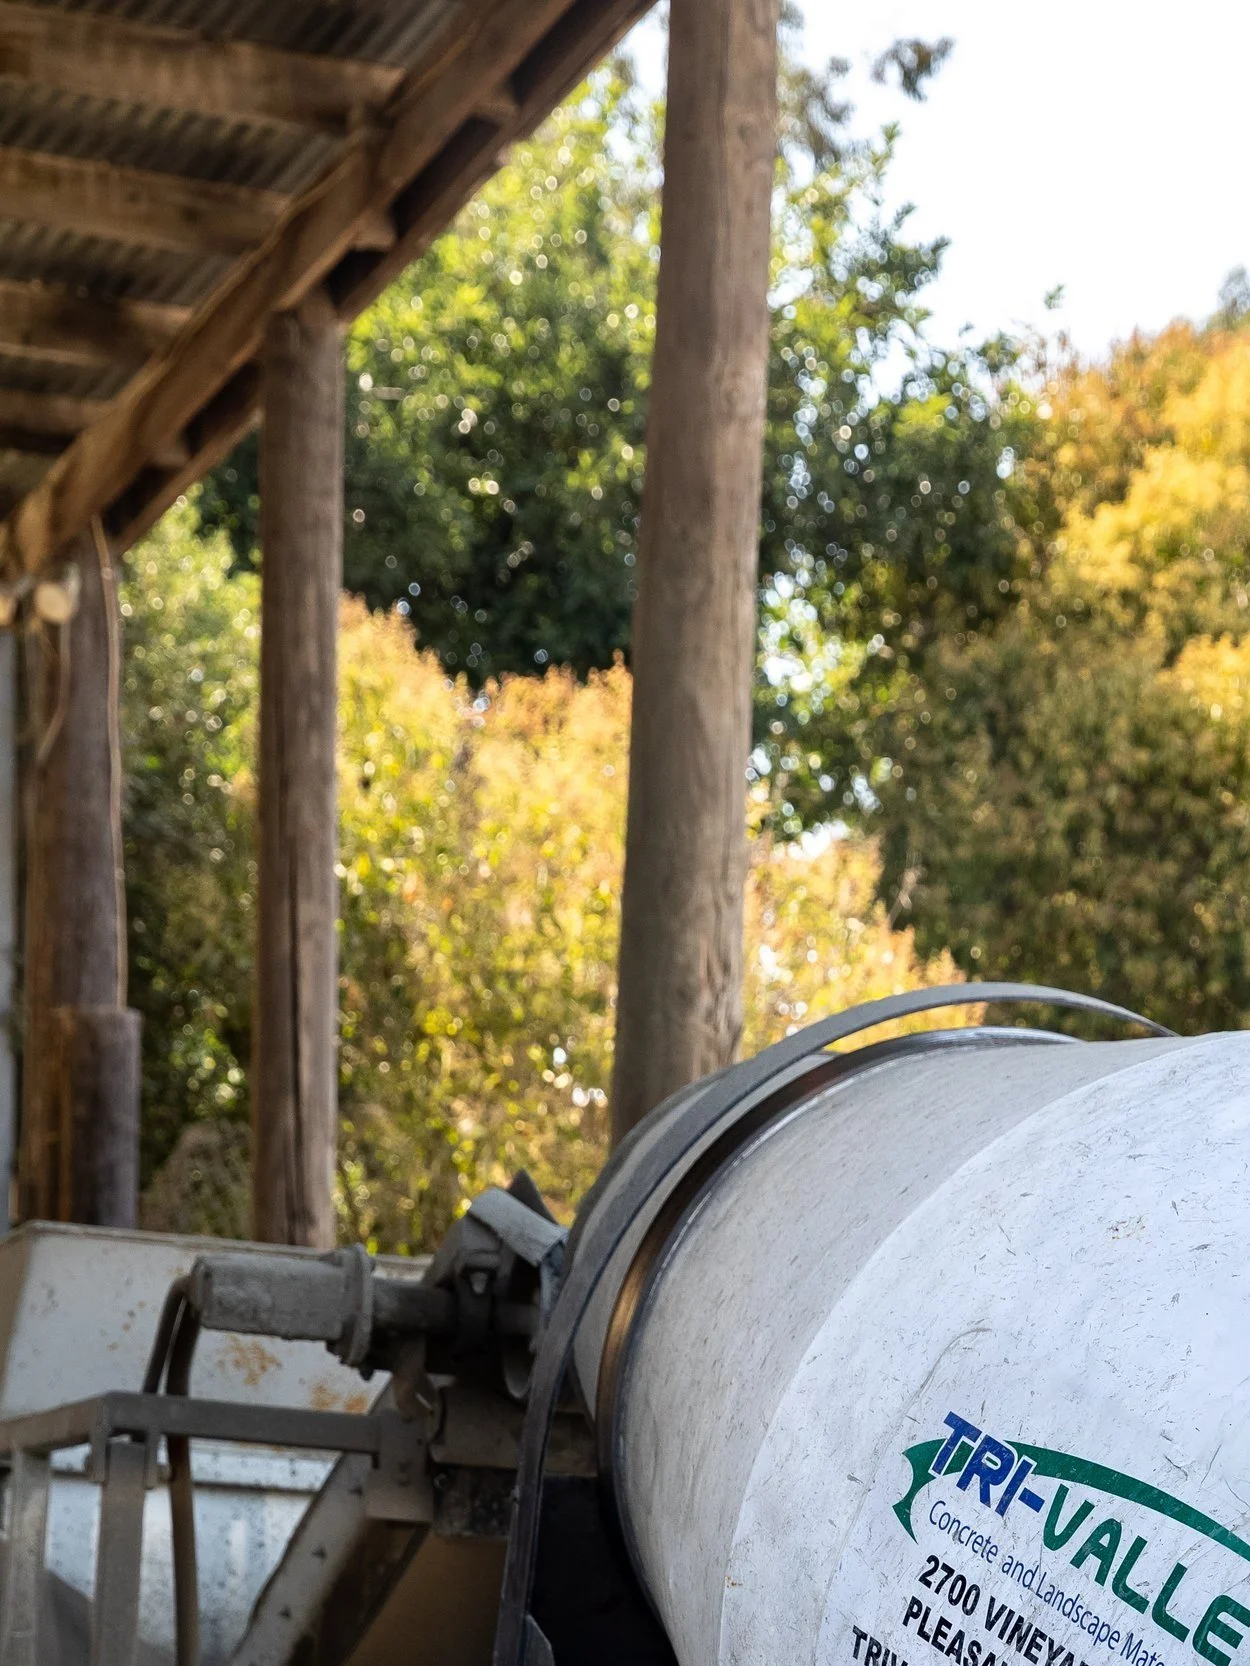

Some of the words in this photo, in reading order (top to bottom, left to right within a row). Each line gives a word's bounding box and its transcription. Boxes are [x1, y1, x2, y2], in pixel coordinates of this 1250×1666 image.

[918, 1554, 981, 1616] 2700
[929, 1500, 998, 1563] Concrete
[1001, 1555, 1039, 1590] and
[1035, 1571, 1120, 1650] Landscape
